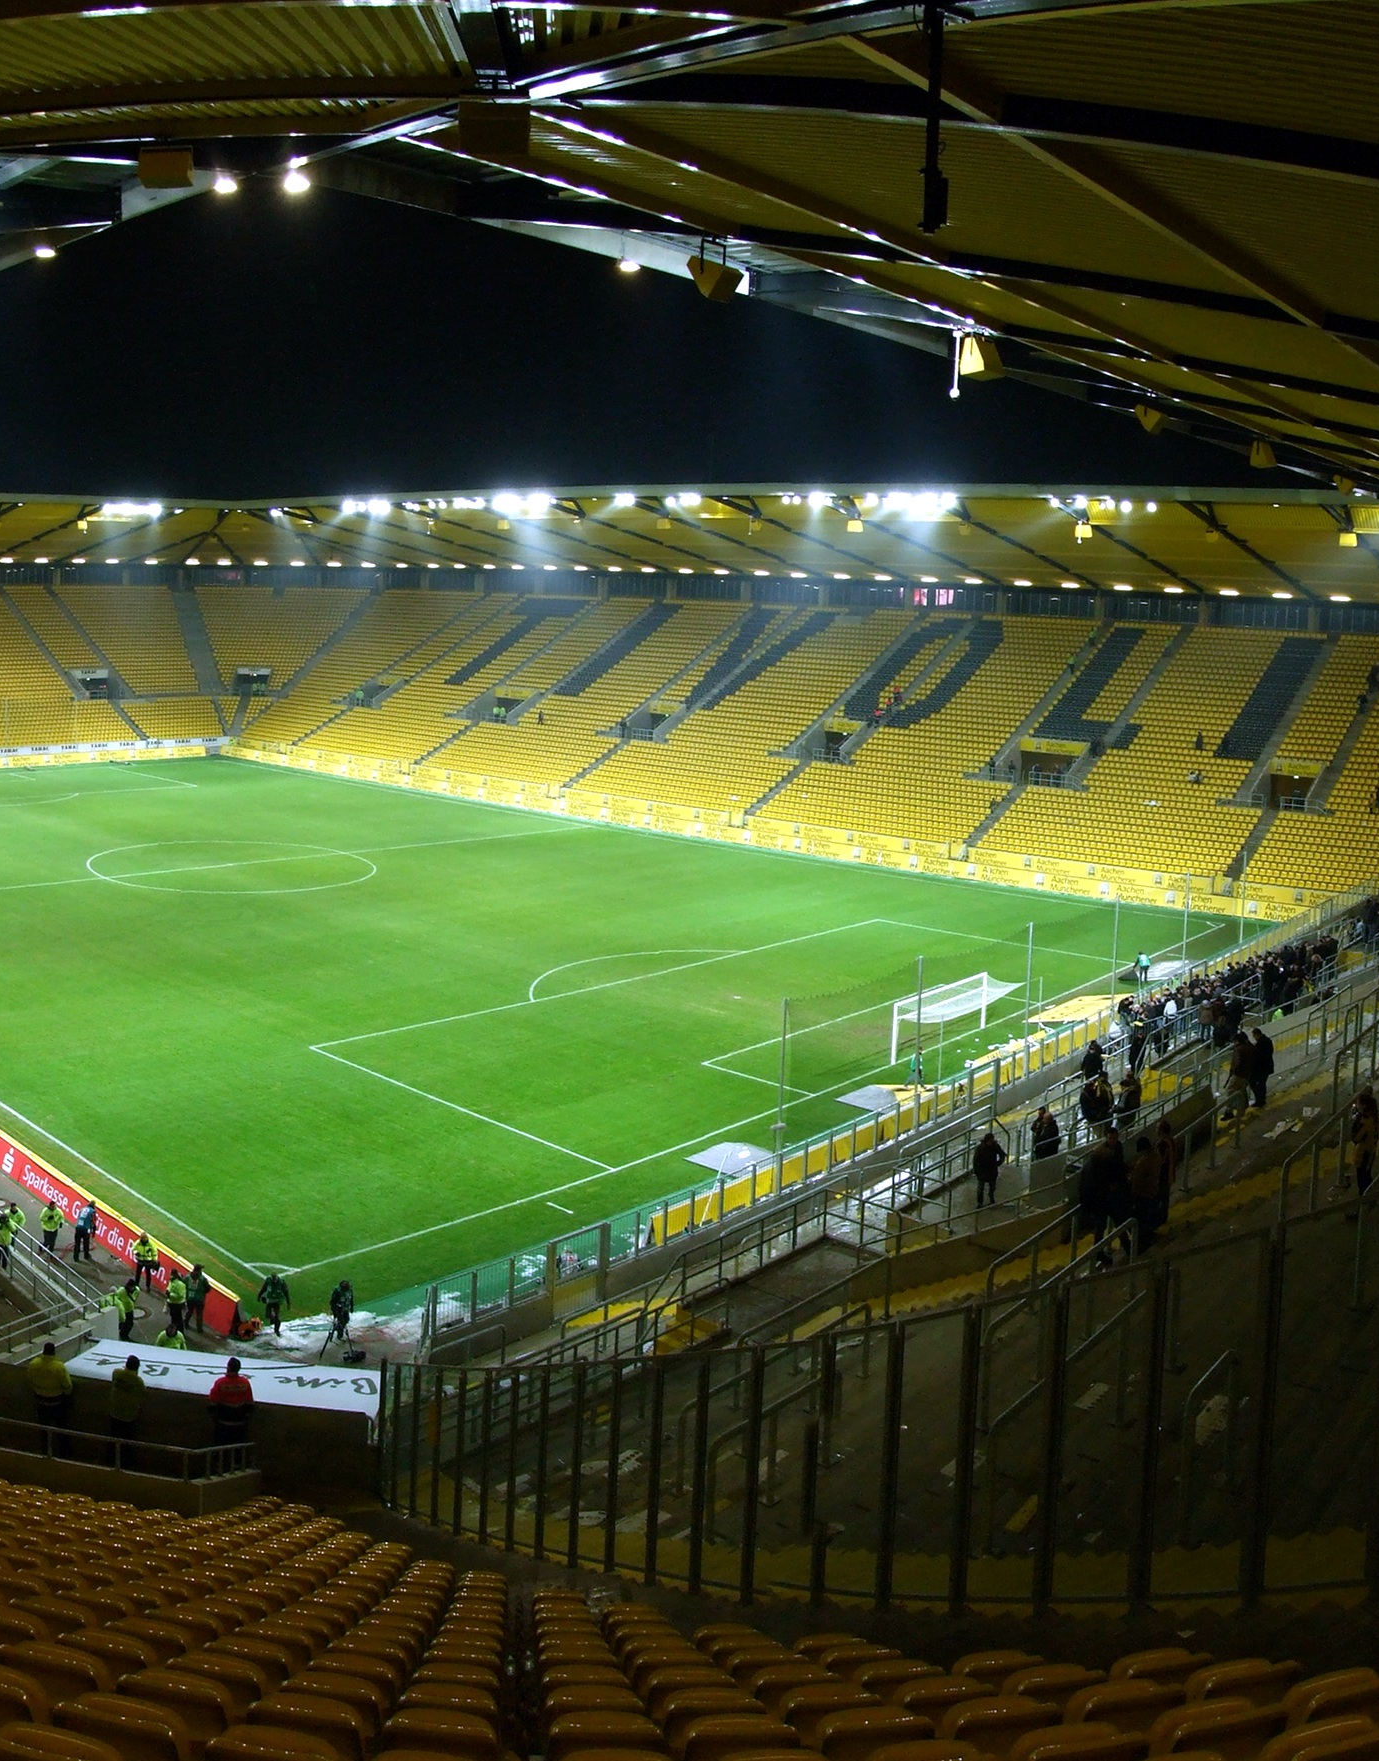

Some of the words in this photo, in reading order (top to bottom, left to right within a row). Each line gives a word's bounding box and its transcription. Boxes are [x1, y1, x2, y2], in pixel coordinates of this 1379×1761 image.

[444, 600, 1325, 760] TIVOLI
[1117, 884, 1144, 894] Aachen
[1265, 903, 1296, 913] Aachen
[22, 1164, 69, 1212] Sparkasse.
[107, 1227, 124, 1251] die
[274, 1375, 379, 1396] Bitte
